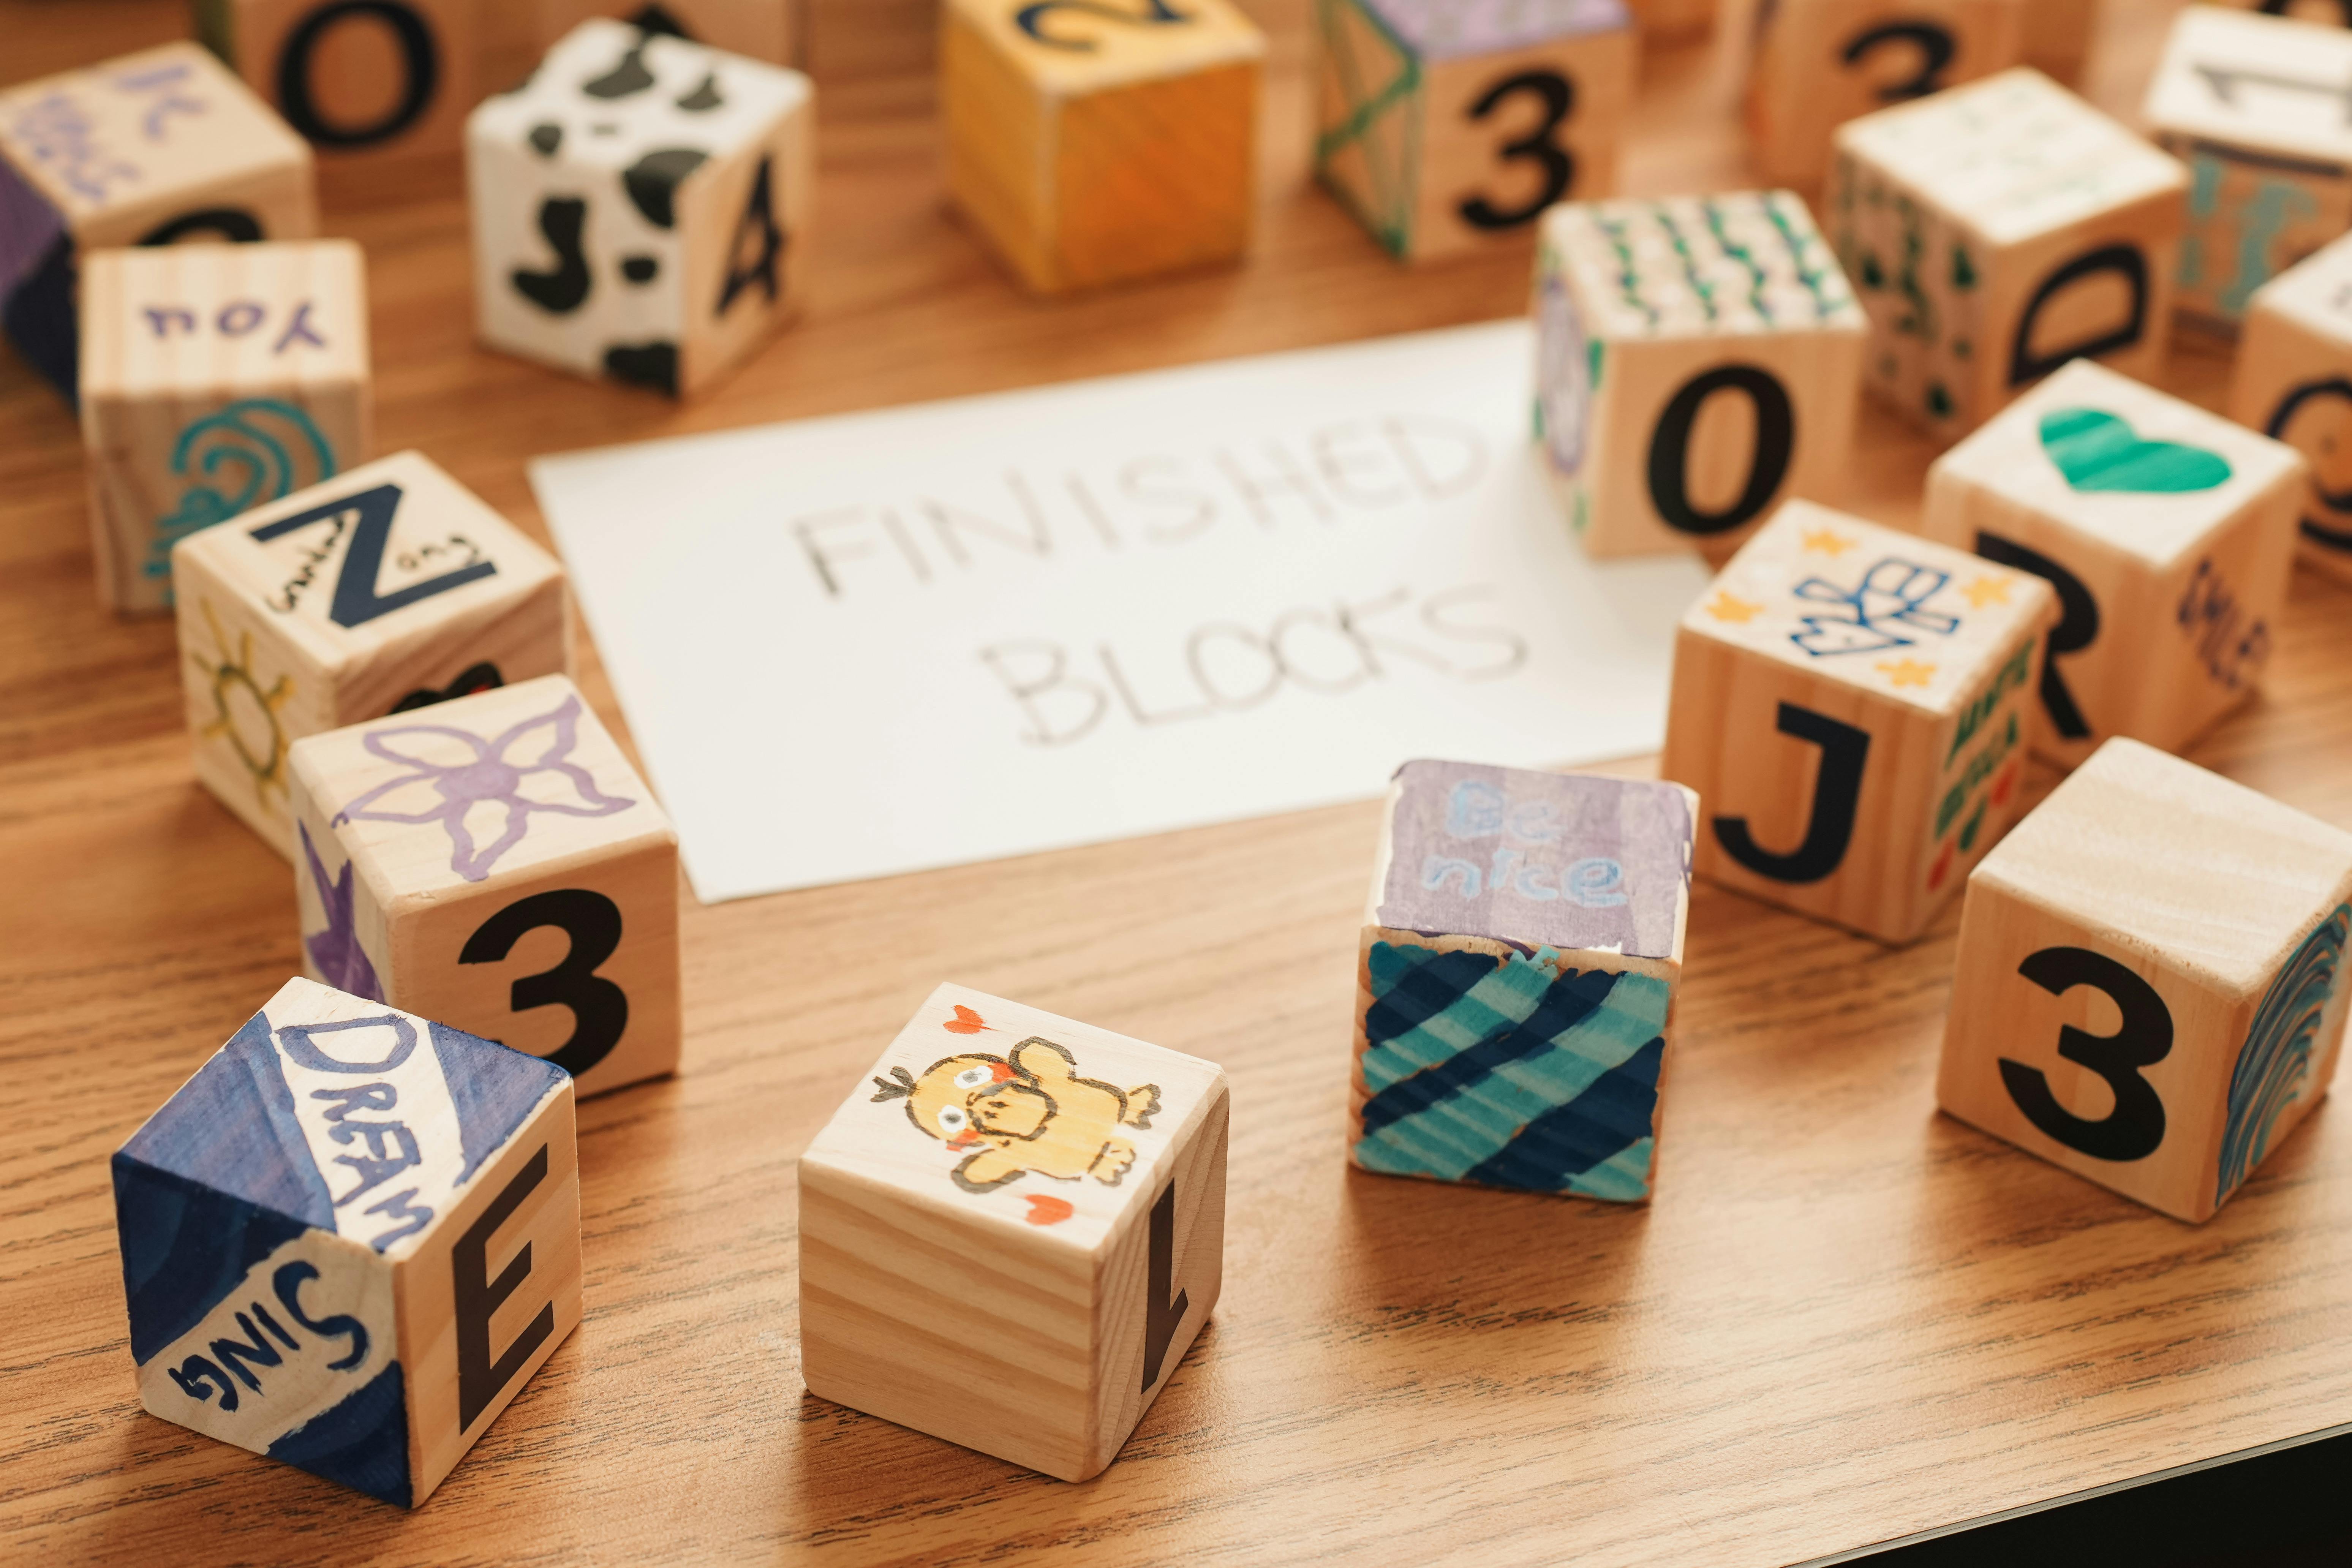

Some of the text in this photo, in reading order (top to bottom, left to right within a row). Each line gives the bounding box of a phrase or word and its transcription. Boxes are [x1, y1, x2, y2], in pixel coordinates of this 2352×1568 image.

[1458, 68, 1574, 230] 3
[712, 156, 783, 317] A
[141, 298, 329, 355] You
[249, 484, 498, 629] Z
[790, 414, 1491, 598] FINISHED
[978, 581, 1529, 748] BLOCKS
[1448, 779, 1569, 840] Be
[1712, 701, 1871, 886] J
[1421, 846, 1628, 908] nice
[458, 889, 629, 1081] 3
[1998, 946, 2175, 1163] 3
[274, 1013, 435, 1254] DREAM
[166, 1259, 370, 1413] SING
[452, 1141, 555, 1436] E
